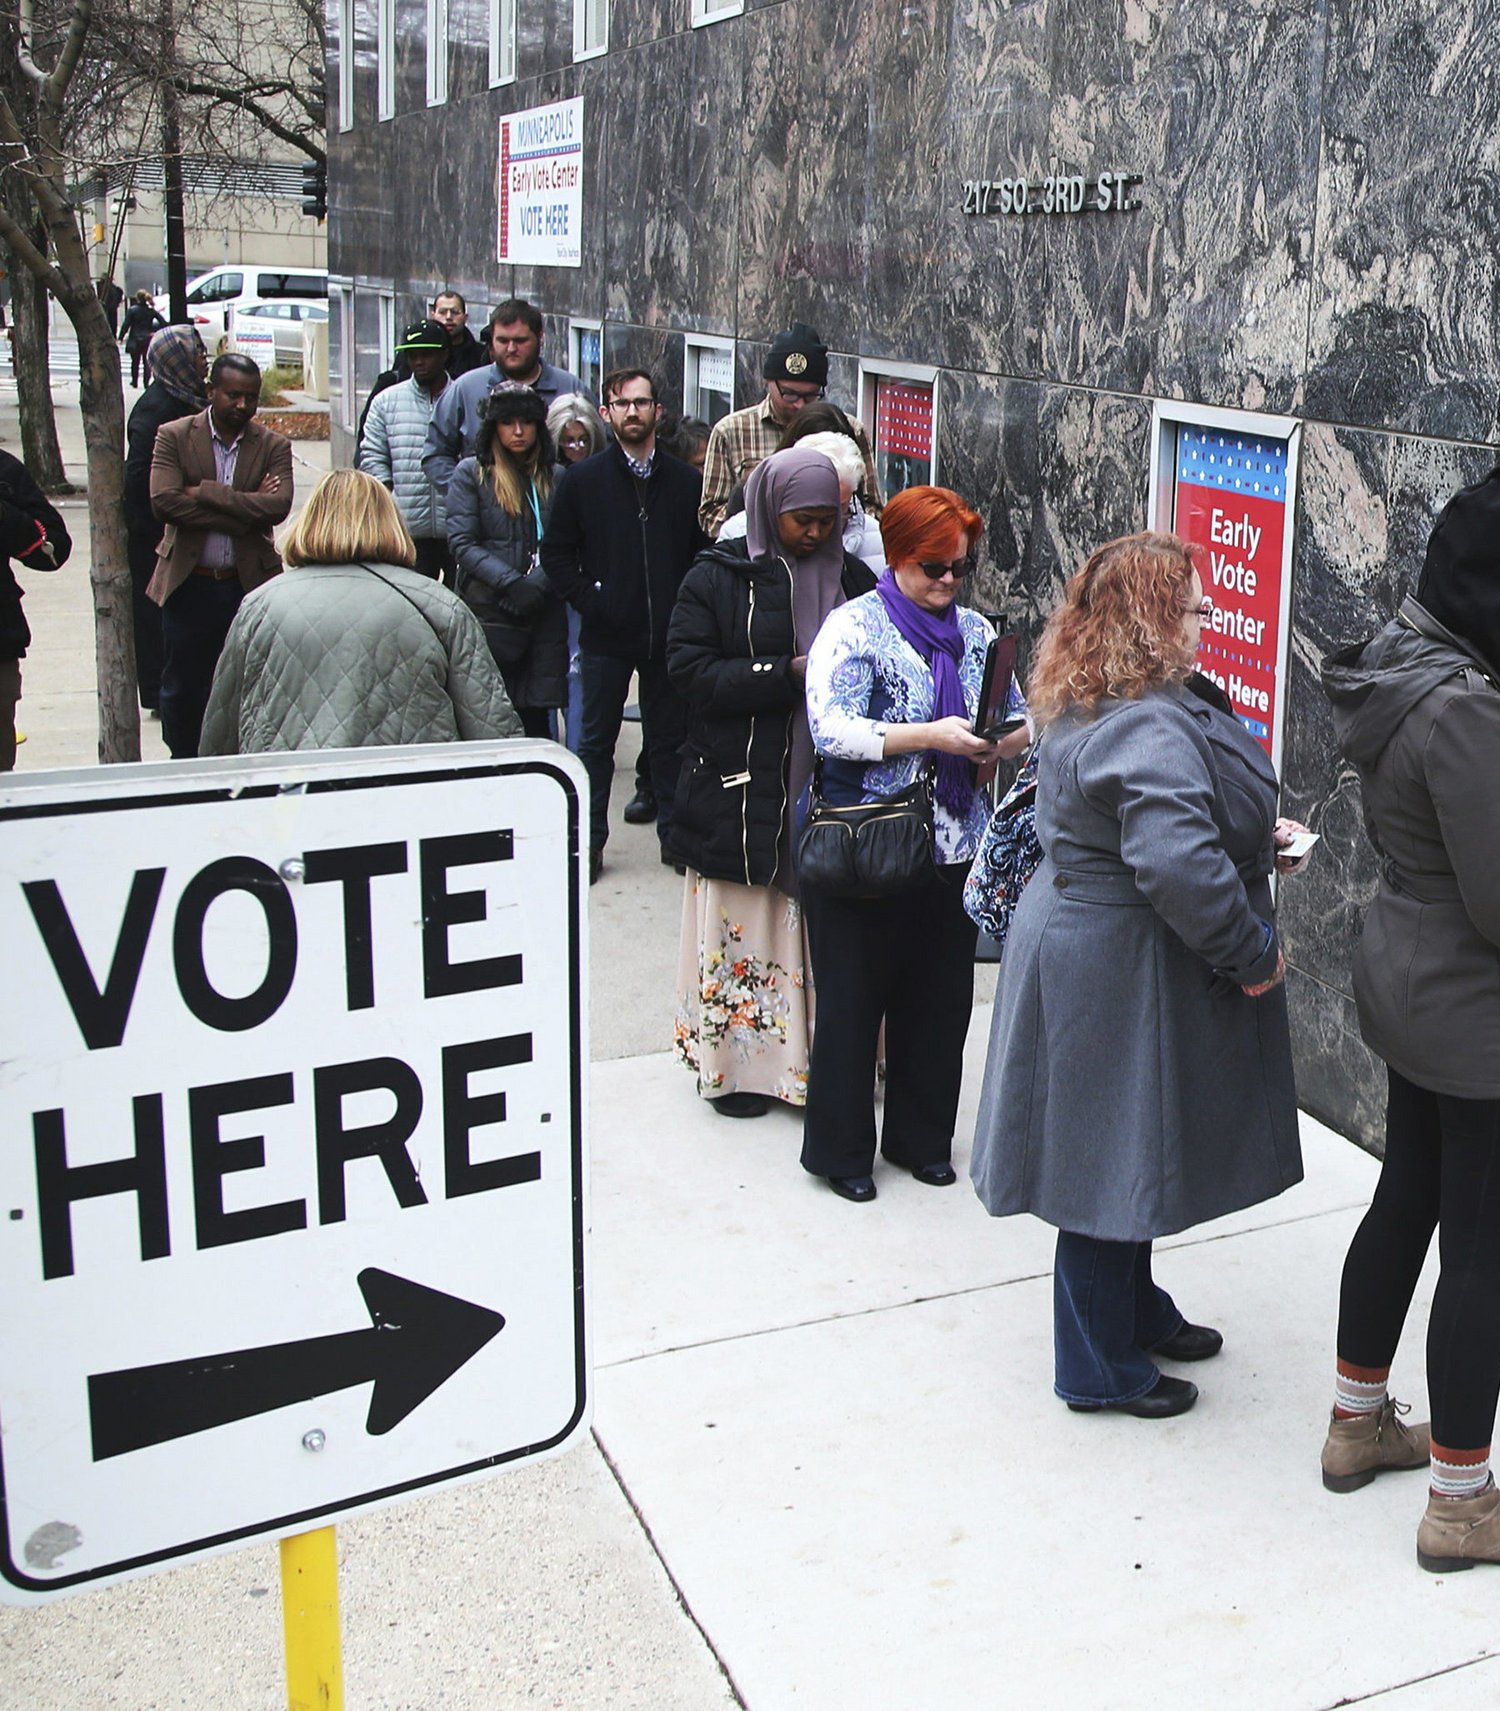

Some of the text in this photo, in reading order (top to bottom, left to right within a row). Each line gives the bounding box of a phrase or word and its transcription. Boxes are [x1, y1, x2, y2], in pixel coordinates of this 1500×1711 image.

[517, 109, 573, 147] MINNEAPOLIS
[513, 161, 578, 198] Early Vote Center
[963, 171, 1131, 214] 217 SO. 3RD ST.
[520, 204, 569, 236] VOTE HERE
[1210, 508, 1262, 561] Early
[1210, 552, 1257, 596] Vote
[1229, 673, 1269, 713] Here
[20, 828, 524, 1051] VOTE
[31, 1032, 542, 1281] HERE
